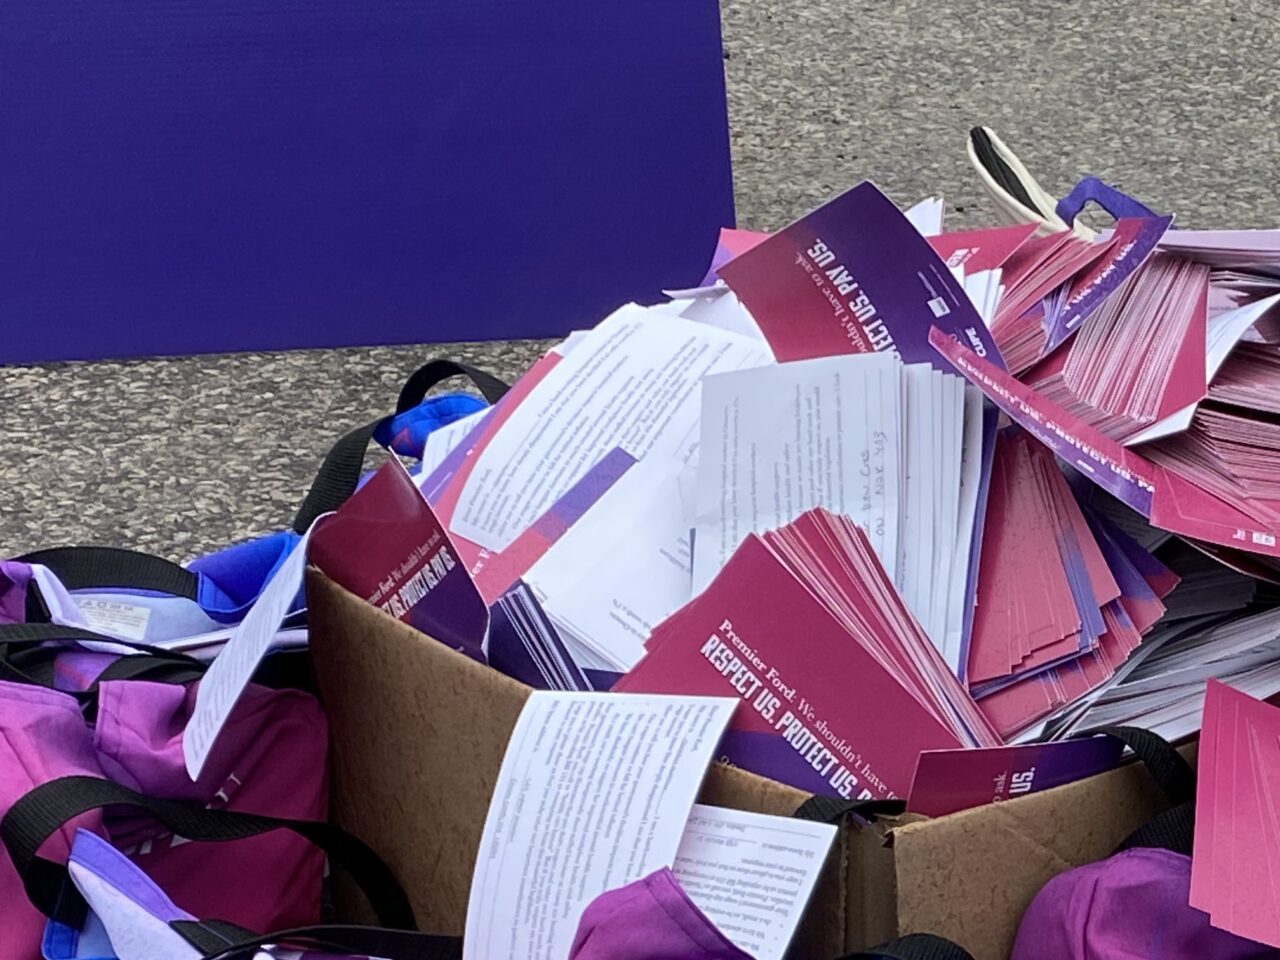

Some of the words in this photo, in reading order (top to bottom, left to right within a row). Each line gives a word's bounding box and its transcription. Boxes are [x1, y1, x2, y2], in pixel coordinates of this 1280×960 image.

[807, 239, 835, 267] US.
[812, 274, 824, 286] to
[826, 266, 858, 295] PAY
[822, 288, 844, 316] have
[849, 290, 876, 322] US.
[701, 634, 763, 698] RESPECT
[753, 688, 781, 723] US.
[775, 711, 840, 776] PROTECT
[829, 766, 858, 799] US.
[719, 619, 767, 671] Premier
[765, 668, 796, 703] Ford:
[798, 698, 814, 721] We
[815, 720, 862, 768] shouldn't
[861, 764, 887, 793] have
[1009, 767, 1035, 797] US.
